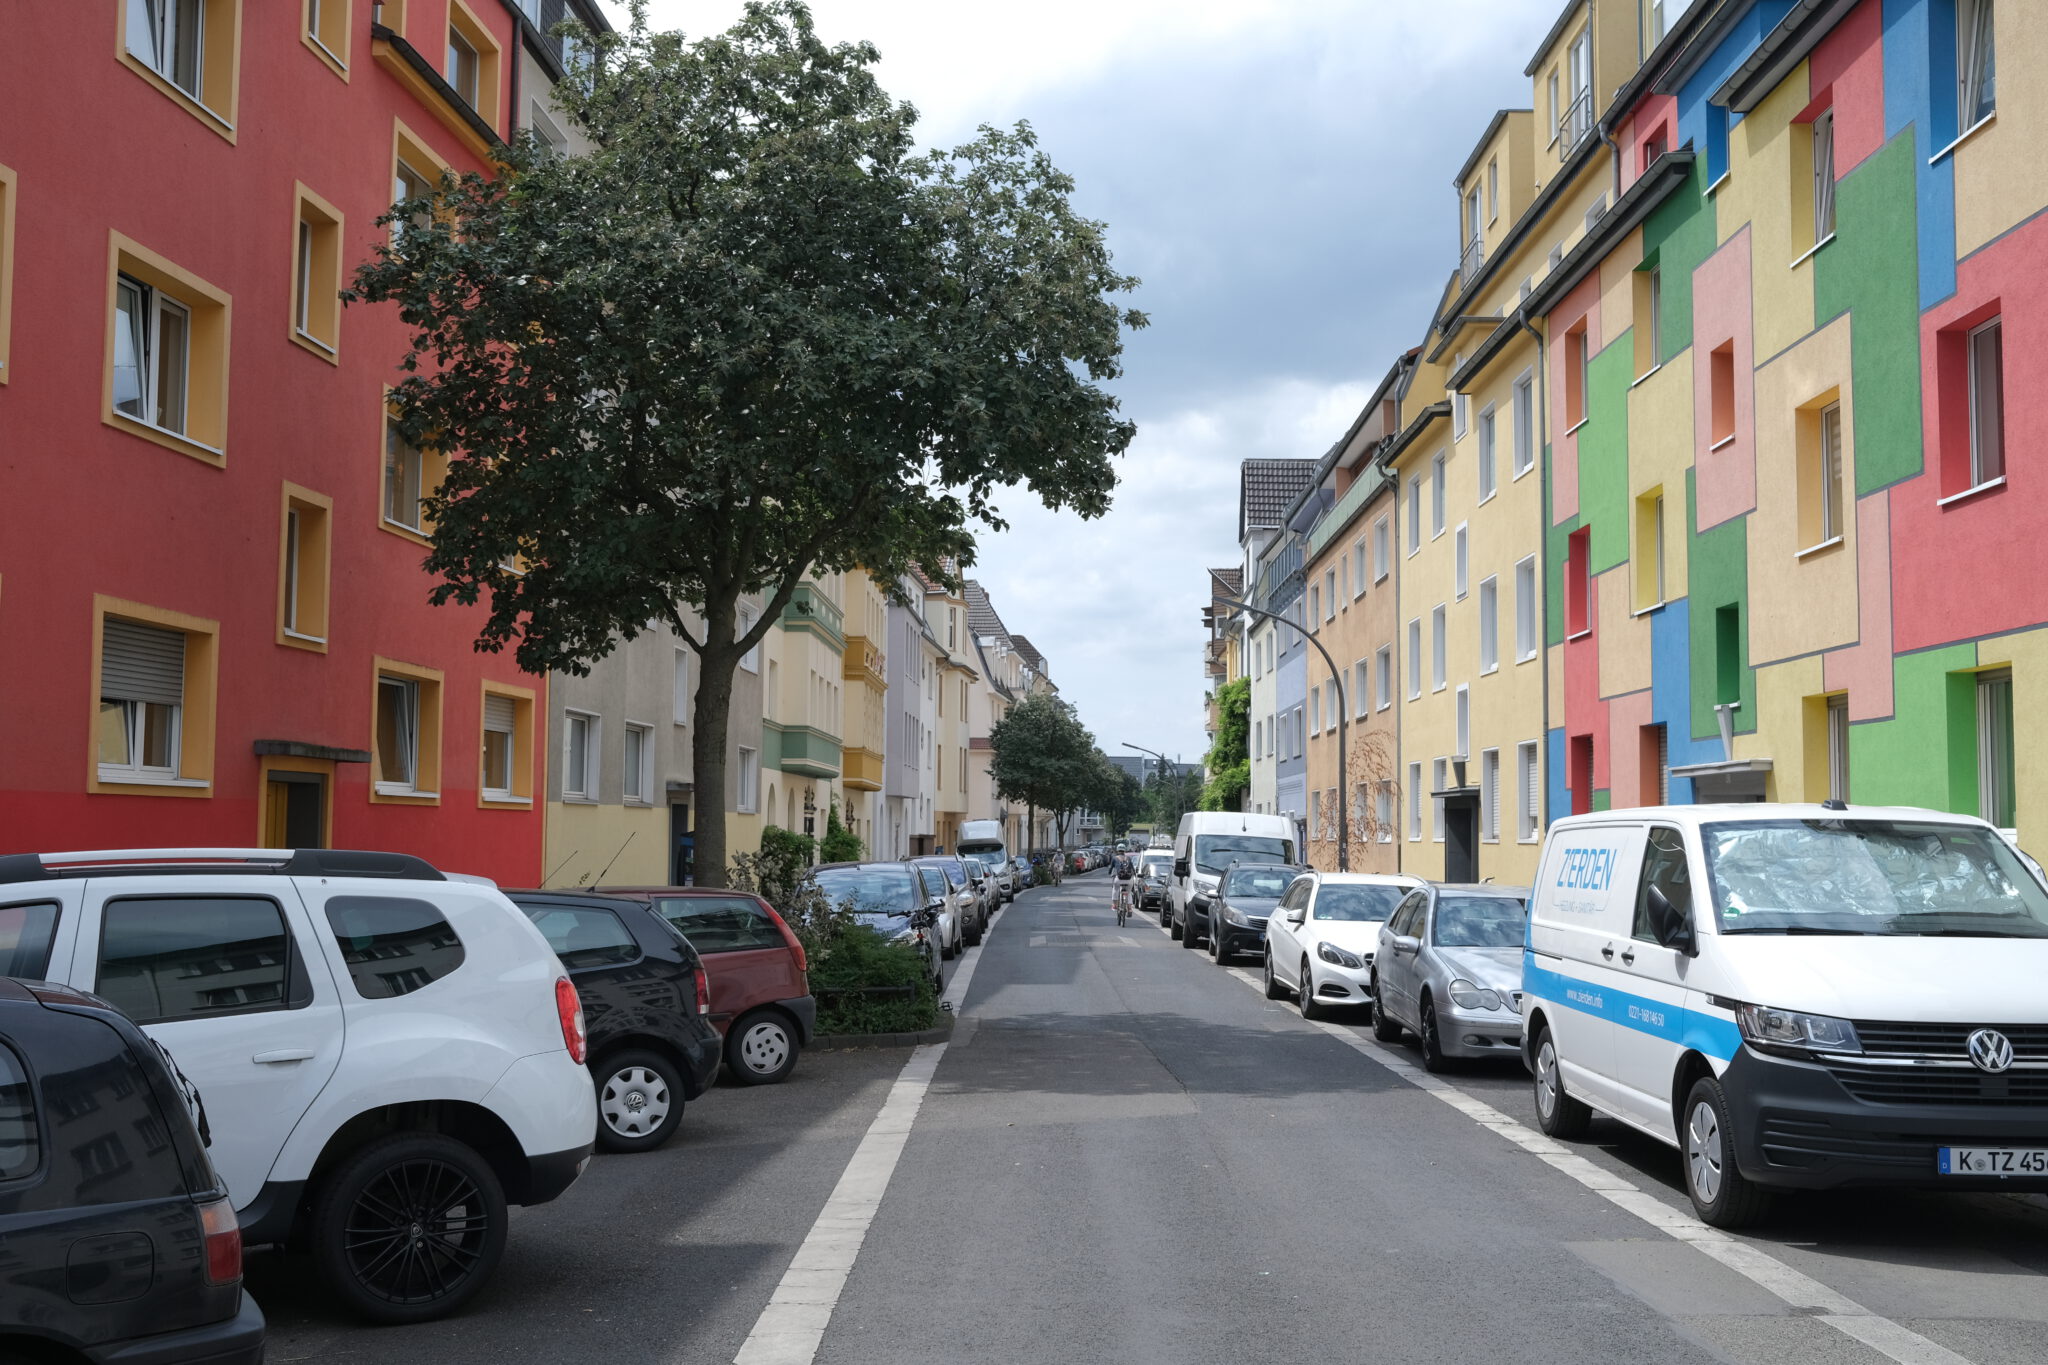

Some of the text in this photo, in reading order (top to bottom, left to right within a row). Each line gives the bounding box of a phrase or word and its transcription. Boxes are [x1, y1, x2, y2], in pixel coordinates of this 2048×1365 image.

[1959, 1151, 2048, 1172] K TZ 45
